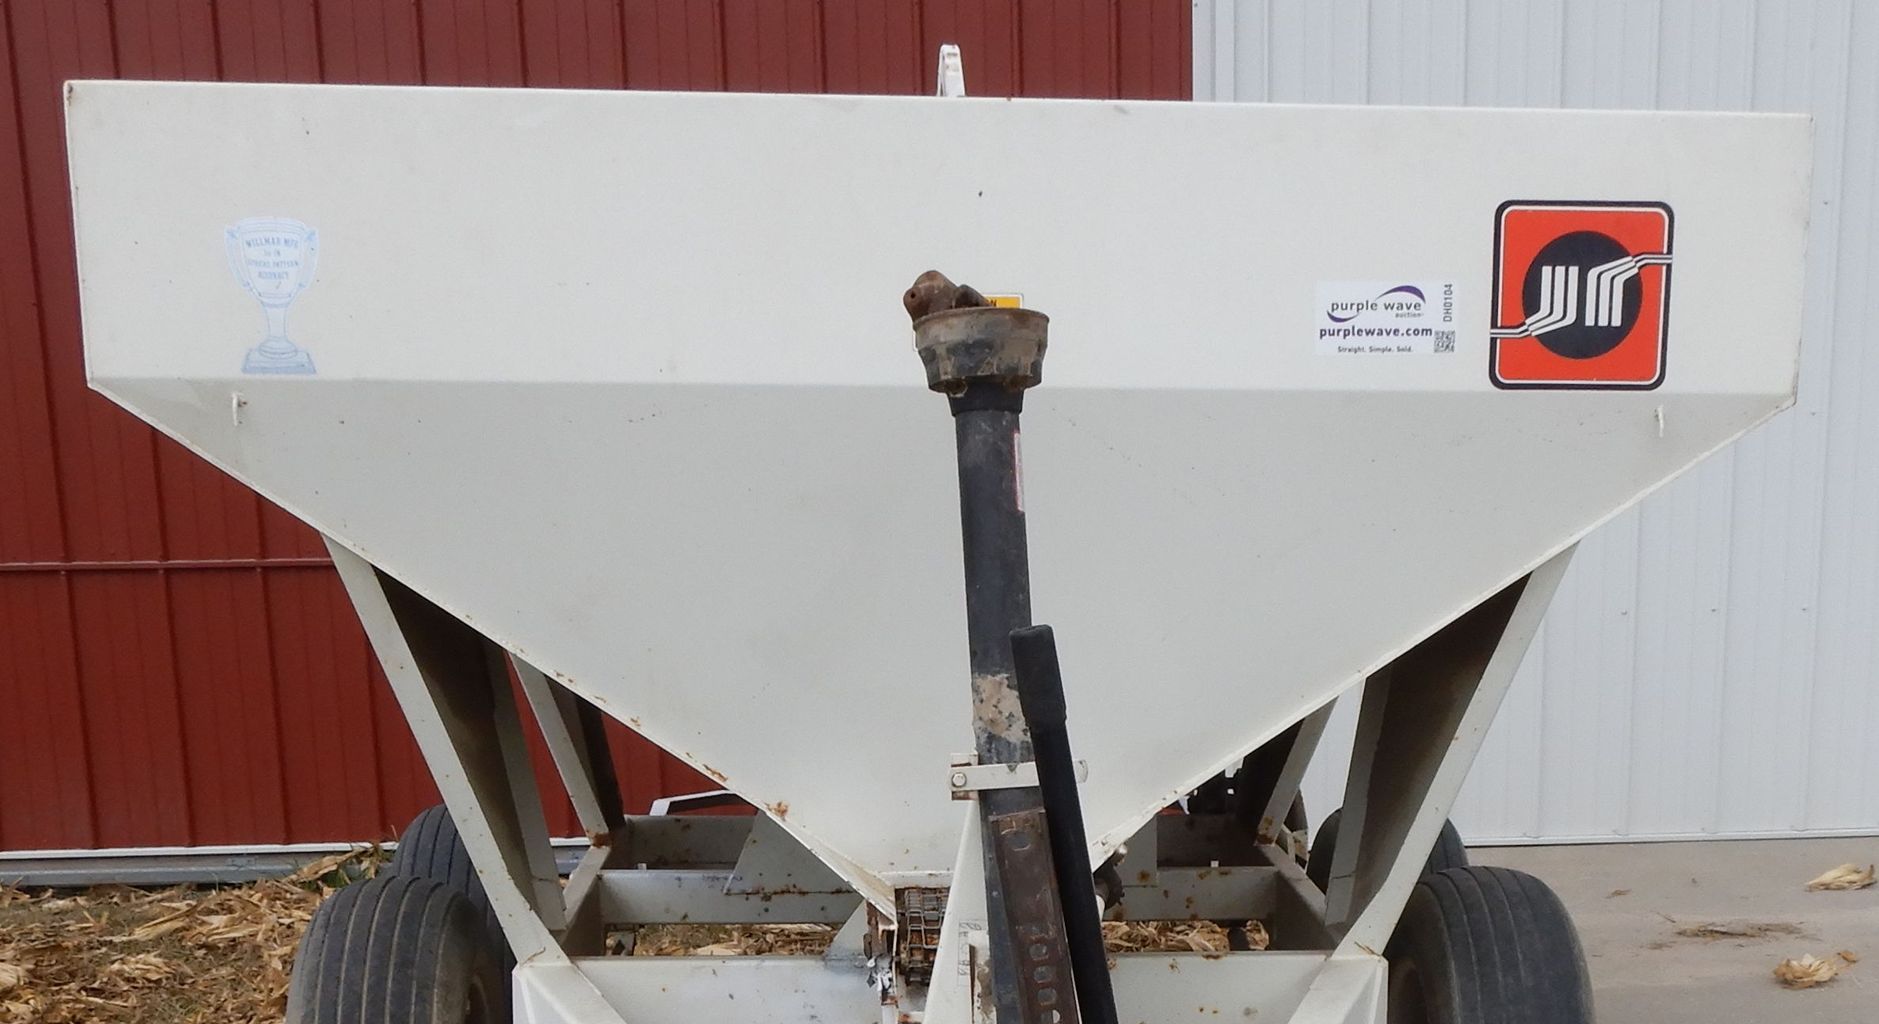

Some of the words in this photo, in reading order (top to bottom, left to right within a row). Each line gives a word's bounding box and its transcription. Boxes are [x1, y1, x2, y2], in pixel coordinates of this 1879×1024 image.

[1331, 300, 1378, 313] purple
[1383, 301, 1422, 311] wave
[1442, 283, 1453, 322] DH0104
[1319, 325, 1433, 340] purplewave.com
[1337, 345, 1366, 354] Straight.
[1368, 345, 1394, 354] Simple.
[1396, 345, 1413, 353] Sold.
